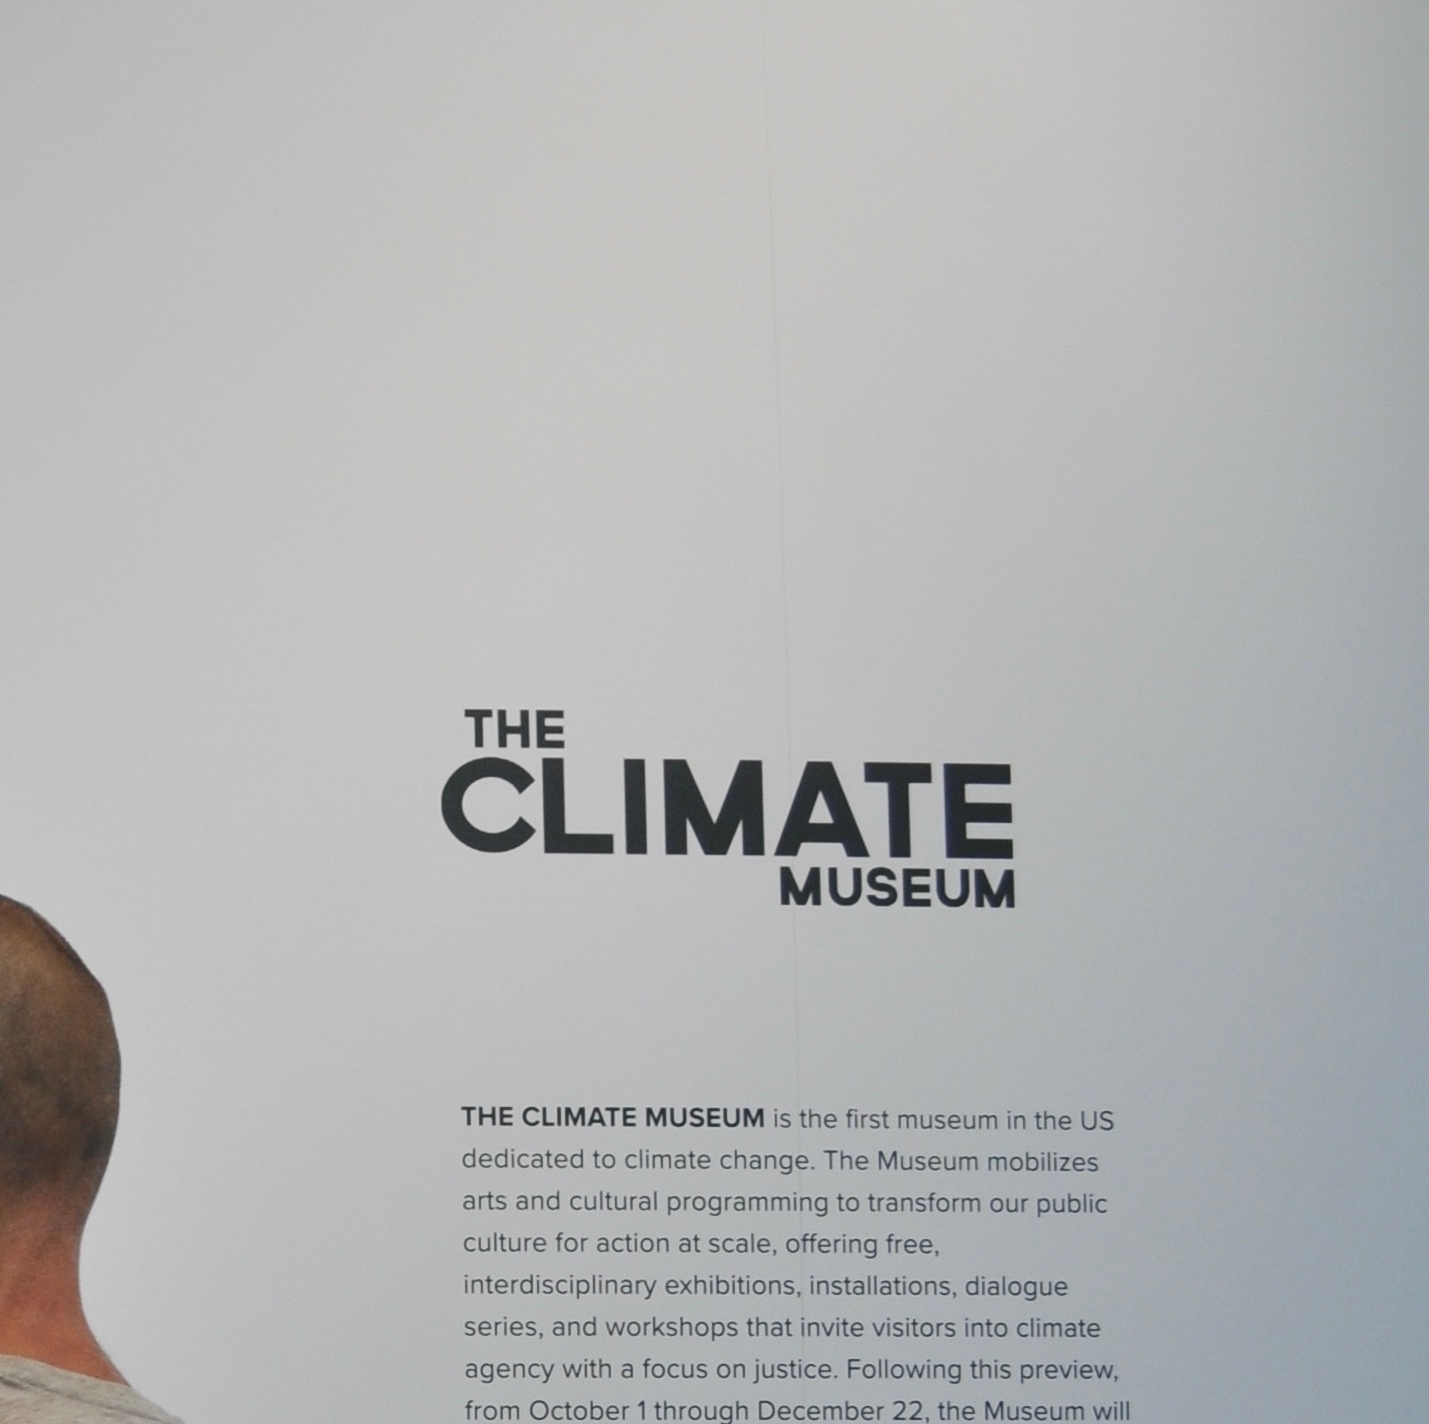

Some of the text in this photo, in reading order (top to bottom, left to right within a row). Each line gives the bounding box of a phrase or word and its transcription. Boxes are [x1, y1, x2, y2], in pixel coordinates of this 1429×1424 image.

[463, 709, 566, 749] THE
[440, 756, 1015, 860] CLIMATE
[778, 866, 1017, 909] MUSEUM
[460, 1105, 1115, 1132] THE CLIMATE MUSEUM is the first museum in the US
[461, 1147, 1100, 1176] dedicated to climate change. The Museum mobilizes
[462, 1189, 1108, 1219] arts and cultural programming to transform our public
[463, 1231, 940, 1260] culture for action at scale, offering free,
[463, 1273, 1069, 1302] interdisciplinary exhibitions, installations, dialogue
[464, 1315, 1102, 1342] series, and workshops that invite visitors into climate
[464, 1357, 1119, 1385] agency with a focus on justice. Following this preview,
[464, 1399, 521, 1421] from
[529, 1399, 631, 1421] October
[636, 1399, 646, 1421] 1
[757, 1399, 885, 1422] December
[892, 1399, 930, 1424] 22,
[936, 1400, 976, 1422] the
[984, 1400, 1086, 1422] Museum
[1092, 1400, 1131, 1422] will
